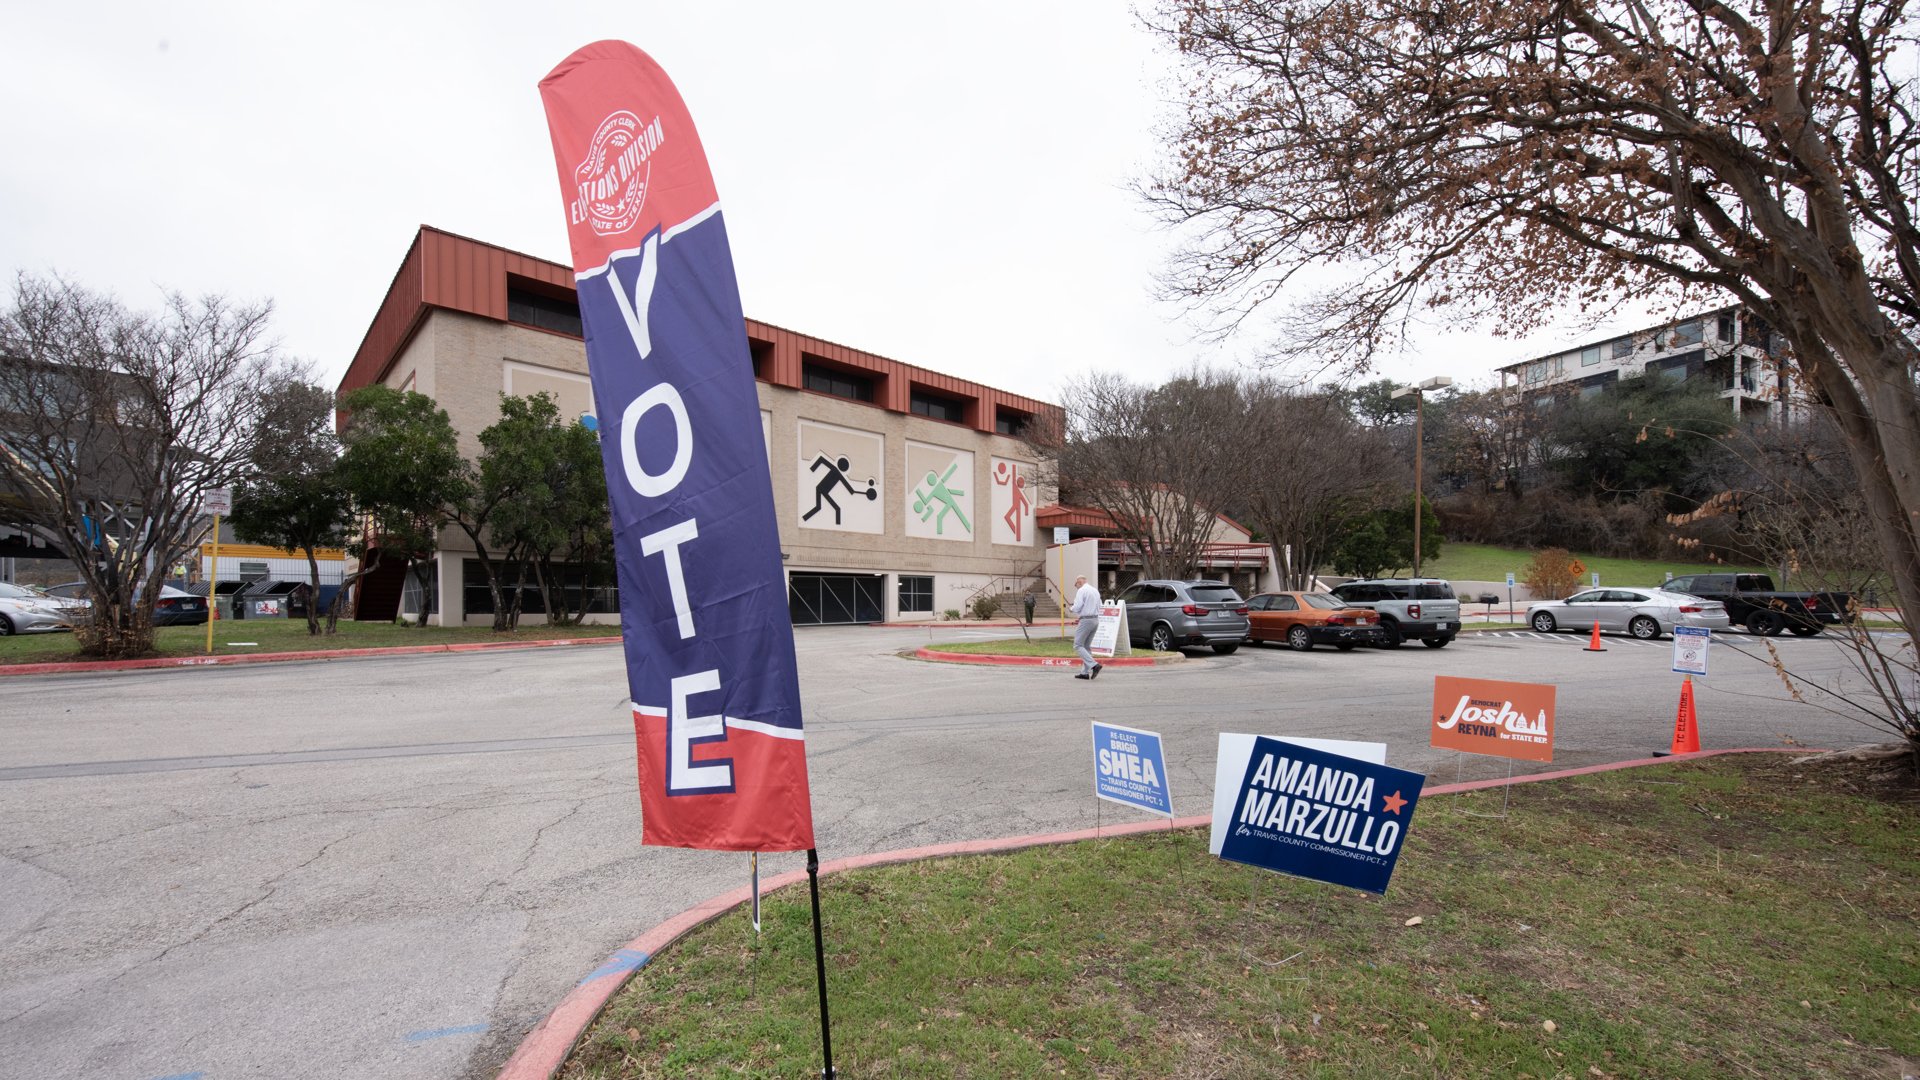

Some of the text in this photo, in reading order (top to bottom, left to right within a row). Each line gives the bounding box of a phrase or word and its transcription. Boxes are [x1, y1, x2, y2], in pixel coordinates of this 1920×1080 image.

[580, 117, 636, 174] TRAVIS COUNTY CLERK
[618, 115, 664, 182] DIVISION
[615, 218, 628, 229] OF
[629, 182, 644, 219] TEXAS
[606, 233, 731, 790] VOTE
[1436, 695, 1519, 732] Josh
[1471, 699, 1501, 708] DEMOCRAT
[1678, 692, 1688, 732] ELECTIONS
[1110, 731, 1137, 743] RE-ELECT
[1110, 739, 1138, 754] BRIGID
[1458, 723, 1497, 738] REYNA
[1500, 732, 1548, 744] for STATE REP.
[1099, 748, 1160, 788] SHEA
[1108, 776, 1152, 794] TRAVIS COUNTY
[1251, 753, 1375, 812] AMANDA
[1101, 783, 1145, 801] COMMISSIONER
[1145, 794, 1158, 805] PCT.
[1239, 788, 1400, 856] MARZULLO
[1235, 824, 1252, 837] for
[1253, 829, 1278, 841] TRAVIS
[1278, 835, 1310, 849] COUNTY
[1310, 842, 1366, 862] COMMISSIONER
[1366, 856, 1382, 866] PCT.
